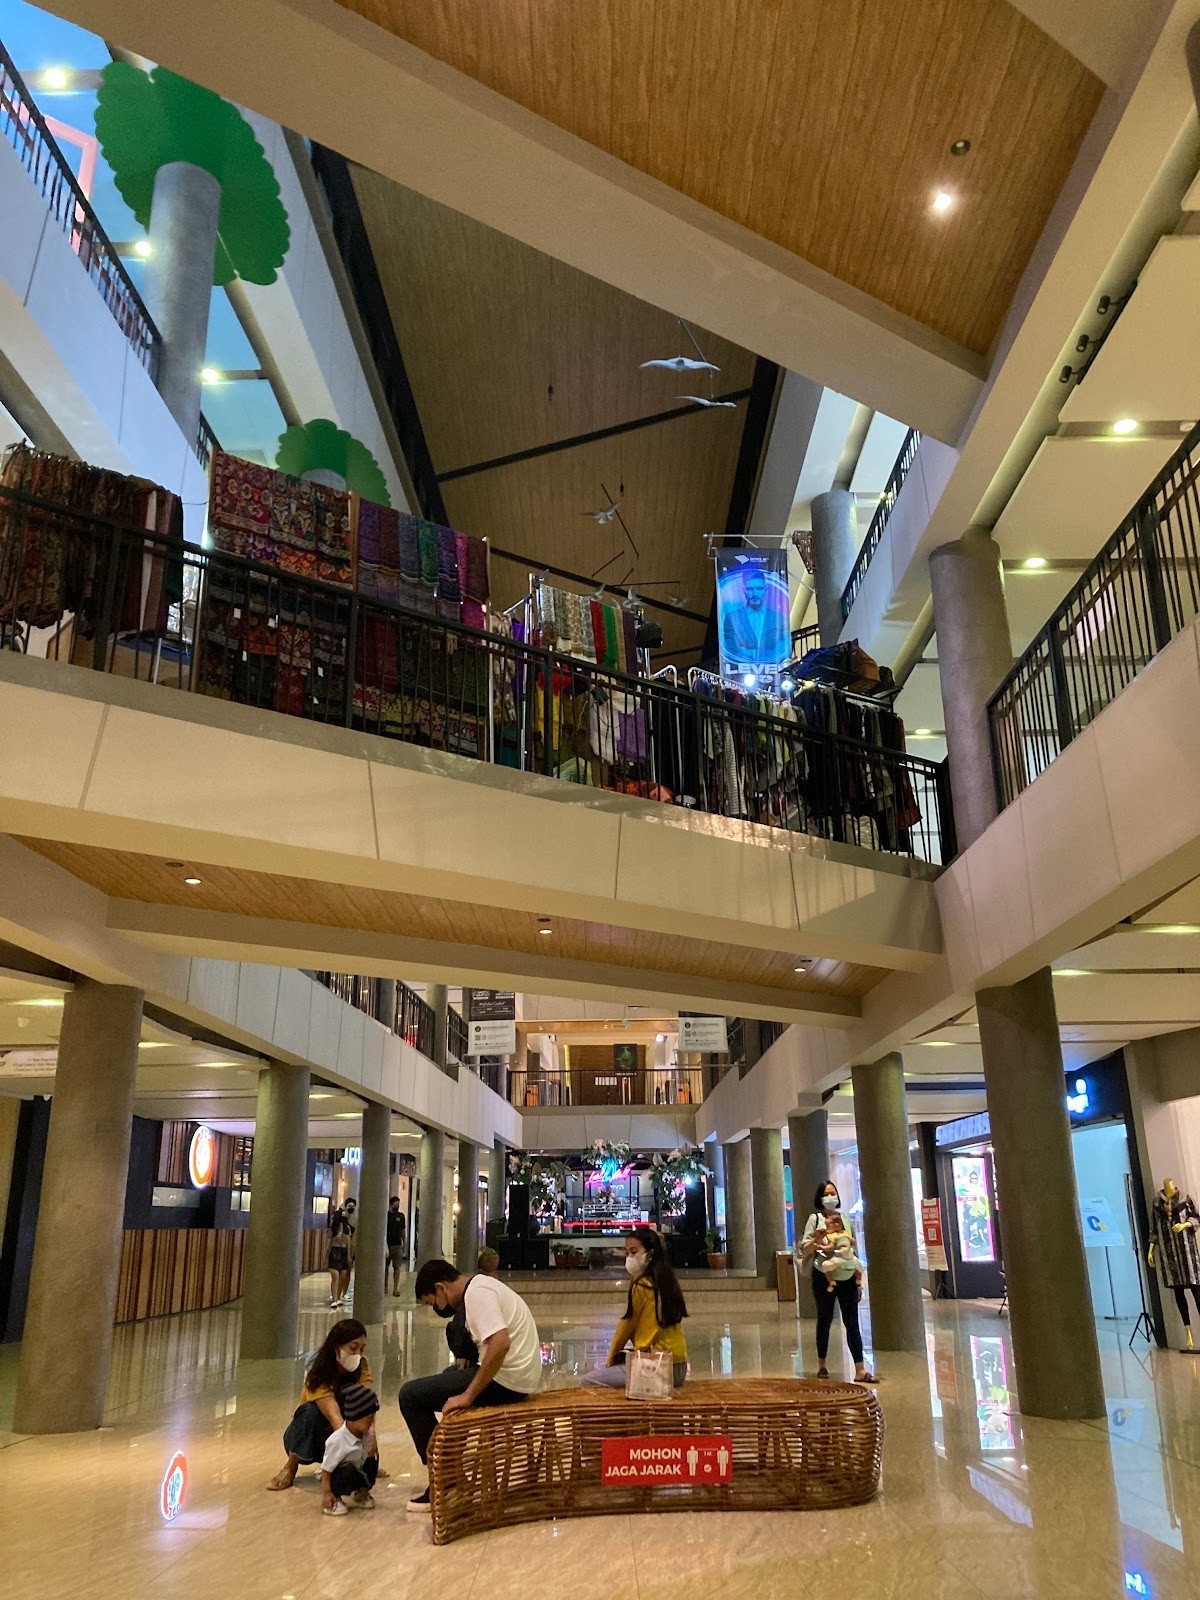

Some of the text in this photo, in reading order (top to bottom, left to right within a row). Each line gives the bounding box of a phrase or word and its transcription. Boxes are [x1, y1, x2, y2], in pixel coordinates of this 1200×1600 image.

[629, 1448, 682, 1460] MOHON
[605, 1464, 682, 1477] JAGA JARAK
